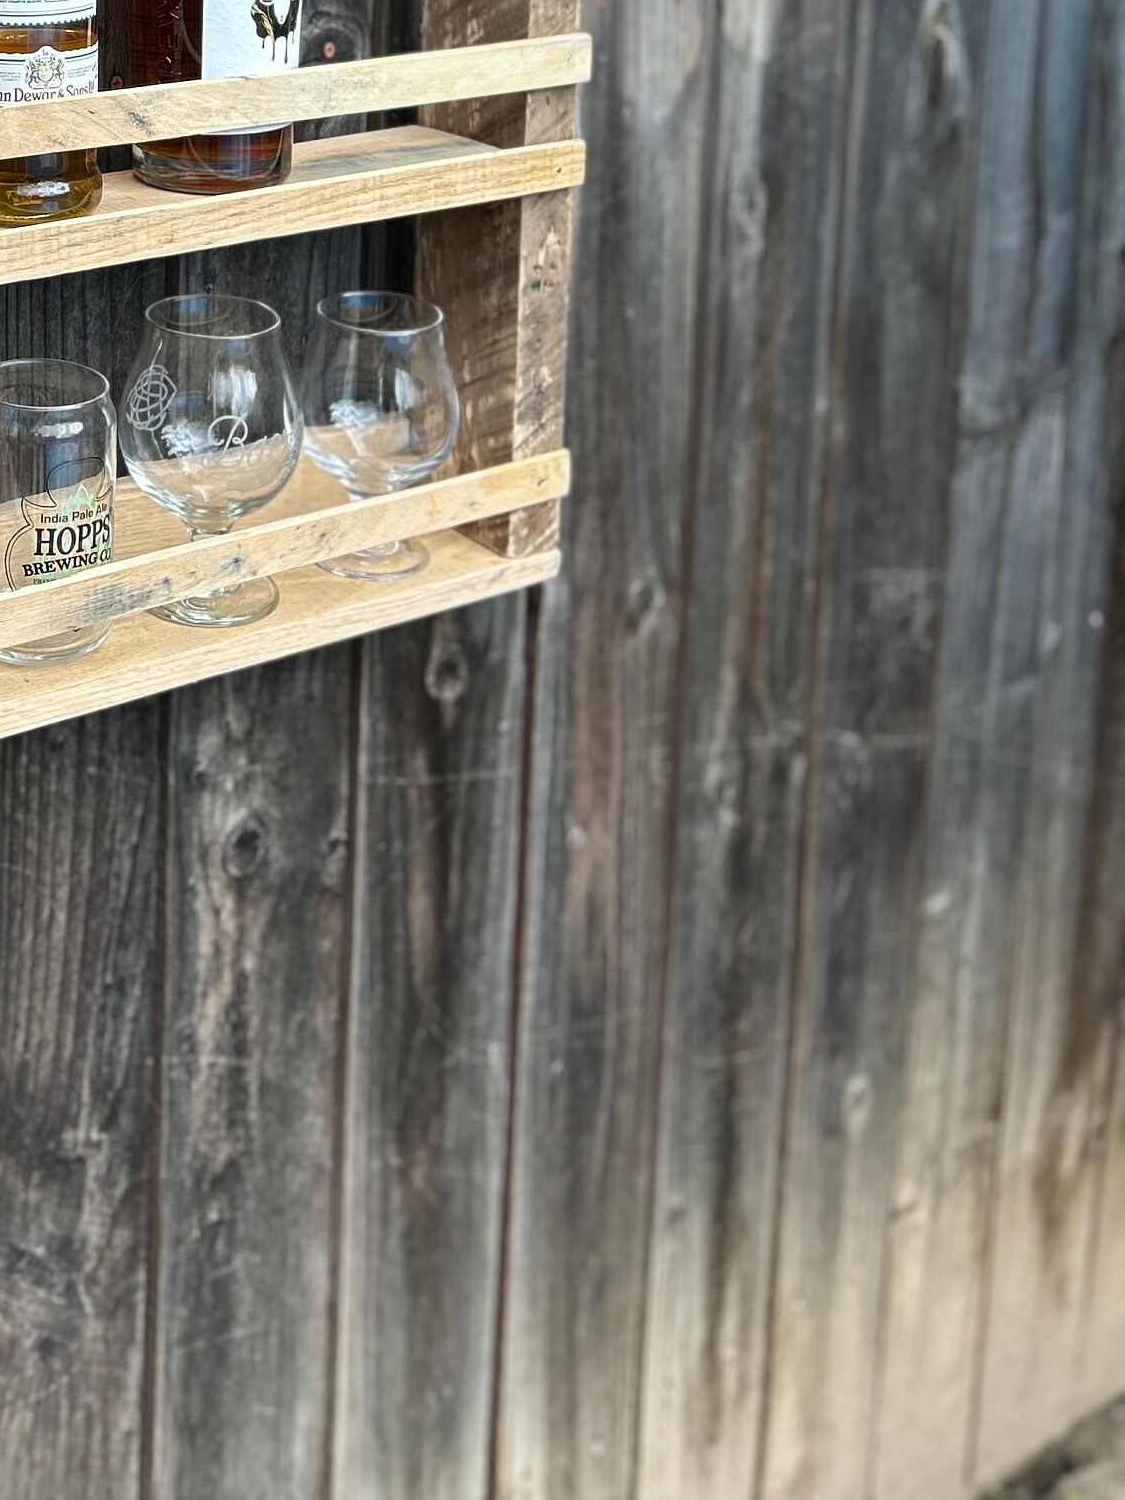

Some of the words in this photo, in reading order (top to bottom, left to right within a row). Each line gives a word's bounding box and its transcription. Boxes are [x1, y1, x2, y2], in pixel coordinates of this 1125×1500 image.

[14, 87, 56, 102] Dewar
[57, 89, 65, 98] &
[40, 513, 69, 524] India
[71, 509, 94, 521] Pale
[95, 503, 108, 516] Ale
[33, 514, 111, 556] HOPPS
[22, 551, 98, 577] BREWING
